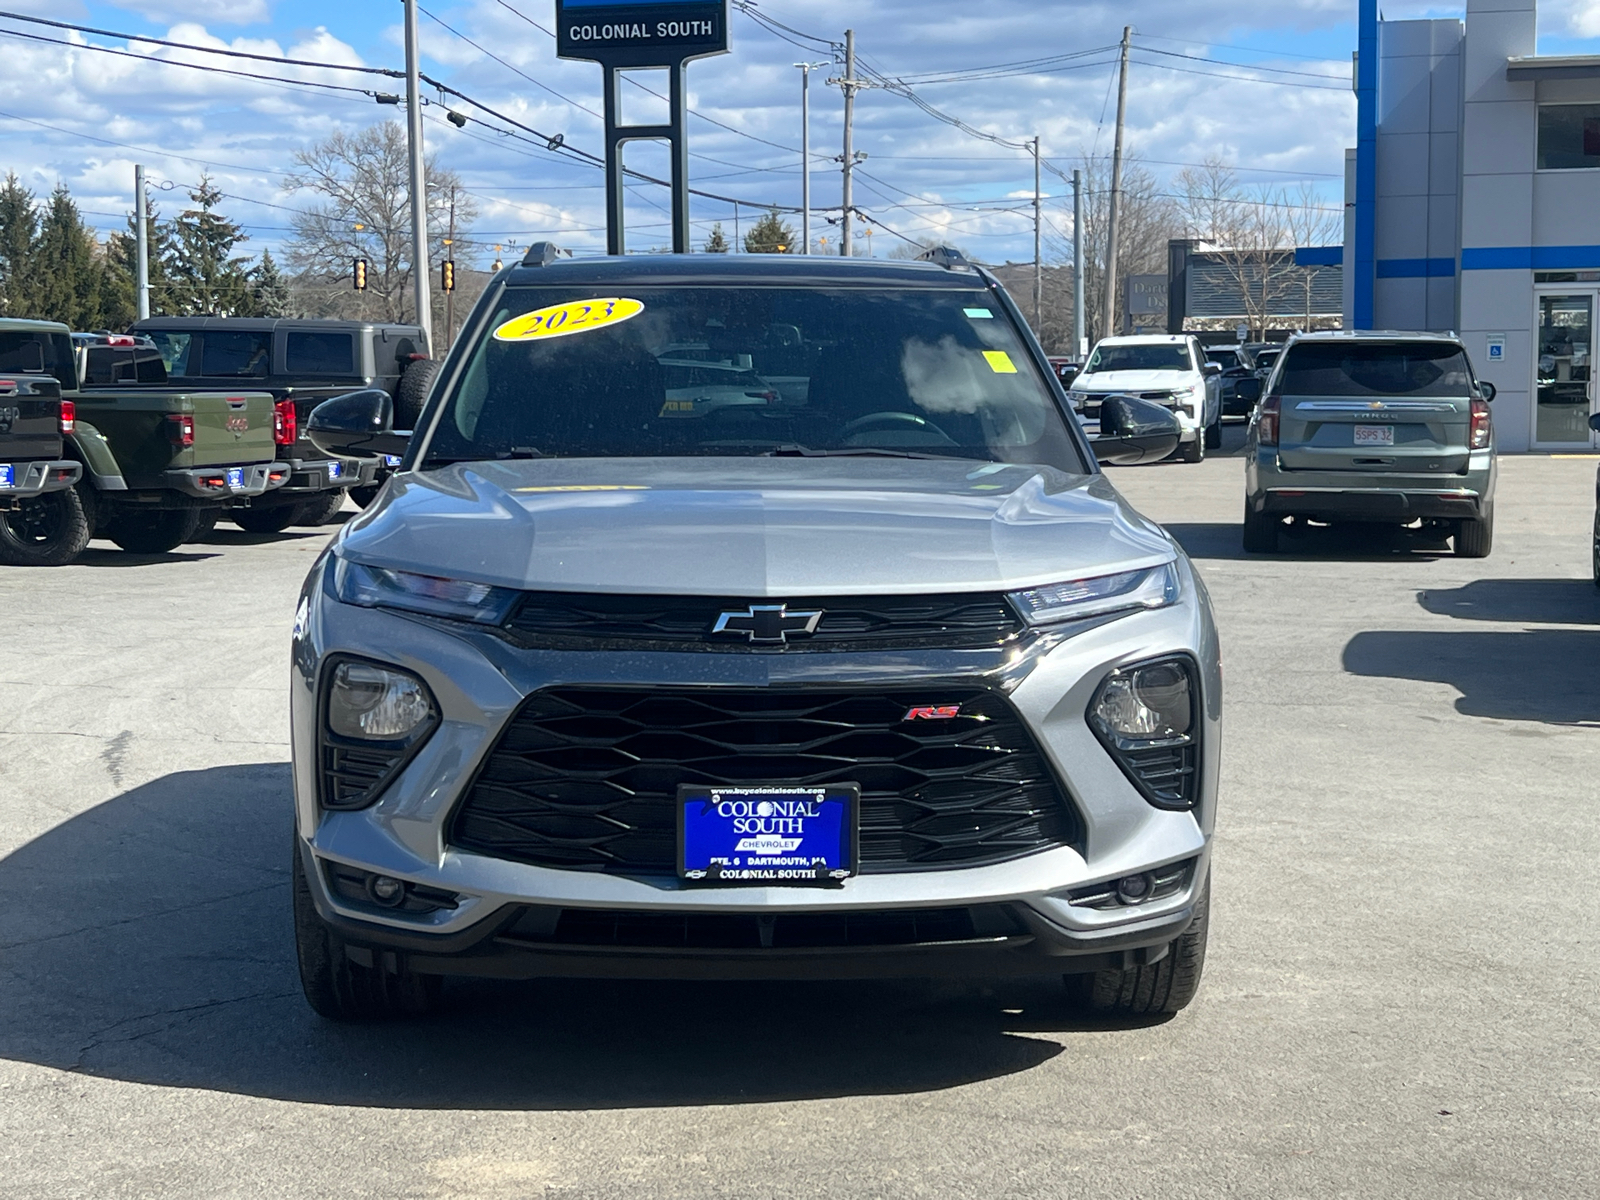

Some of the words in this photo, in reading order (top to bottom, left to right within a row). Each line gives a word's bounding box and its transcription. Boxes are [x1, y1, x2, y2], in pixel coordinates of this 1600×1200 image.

[569, 23, 652, 41] COLONIAL
[656, 20, 713, 37] SOUTH
[520, 302, 616, 336] 2023
[903, 706, 960, 720] RS
[710, 787, 826, 796] www.buycolonialsouth.com
[717, 800, 821, 818] COLONIAL
[733, 817, 804, 834] SOUTH
[742, 840, 795, 849] CHEVROLET
[733, 857, 741, 866] 6
[747, 857, 810, 867] DARTMOUTH,
[719, 869, 777, 879] COLONIAL
[777, 869, 817, 879] SOUTH
